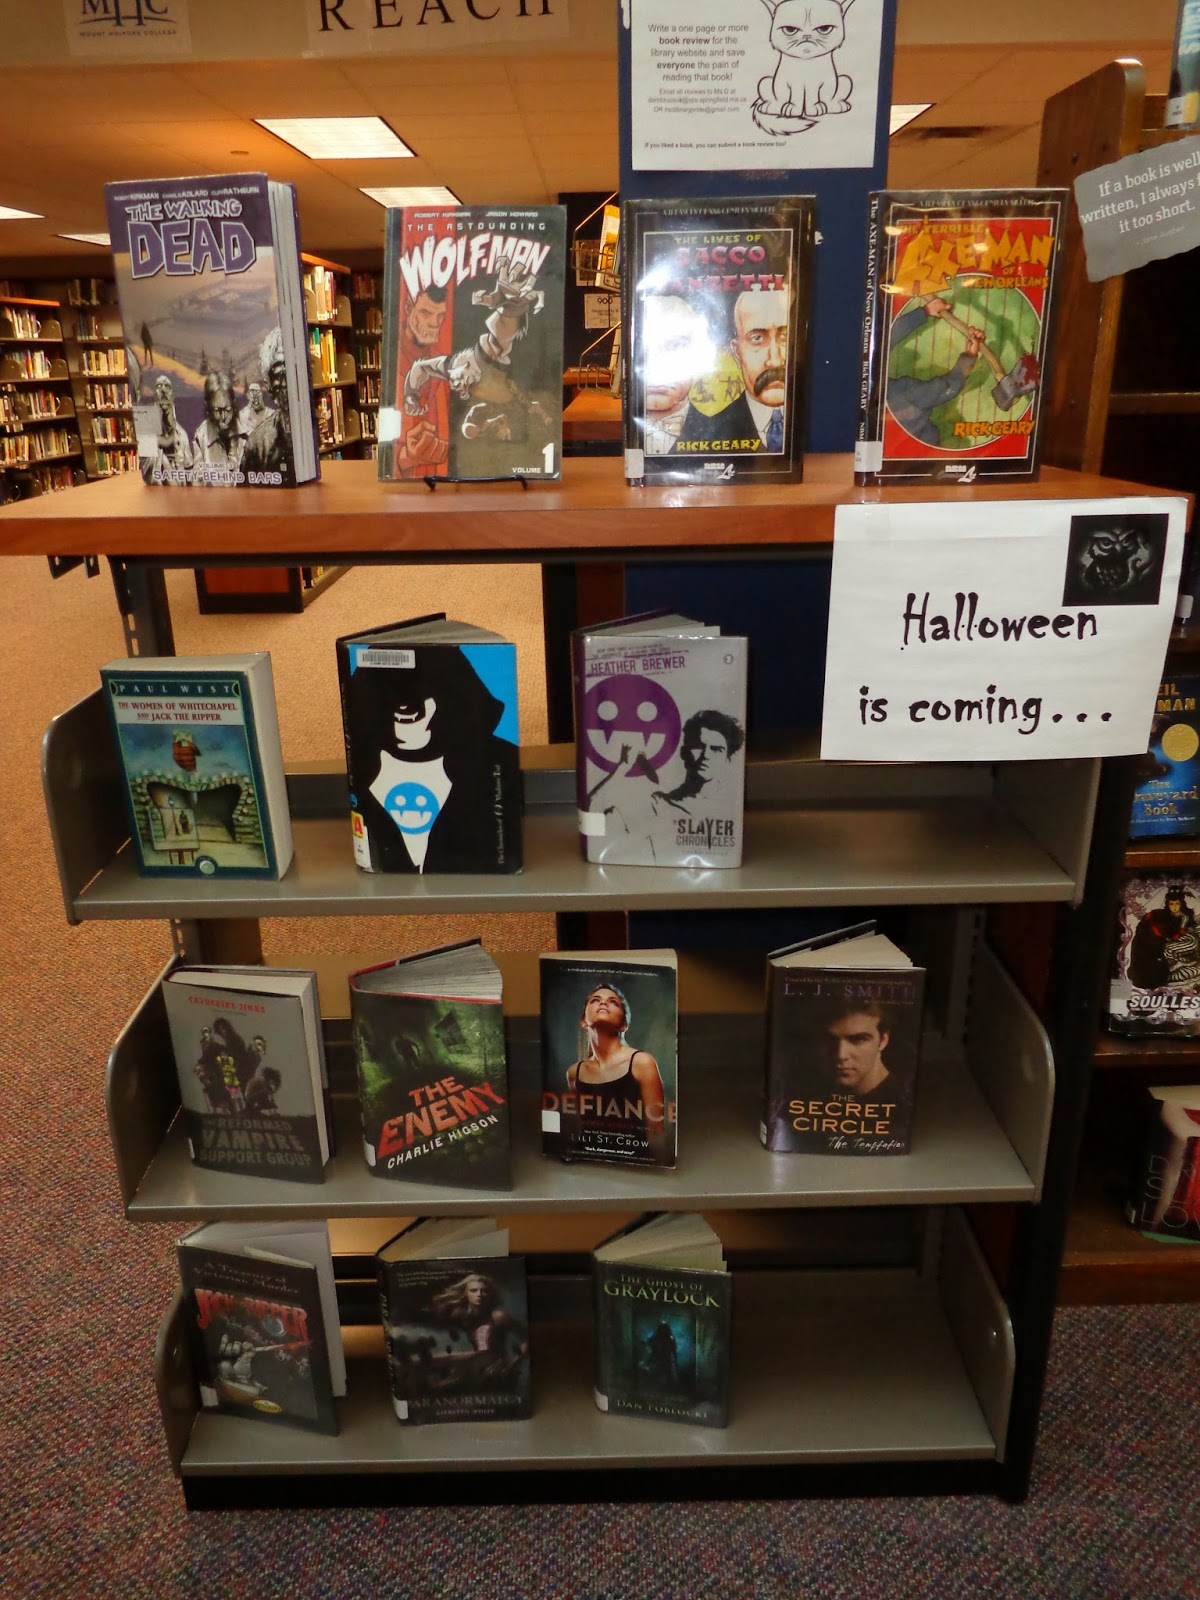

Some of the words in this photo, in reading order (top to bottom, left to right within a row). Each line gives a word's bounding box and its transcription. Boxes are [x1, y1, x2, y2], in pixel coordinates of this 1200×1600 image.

[648, 24, 669, 32] Write
[696, 26, 715, 34] page
[651, 49, 675, 58] library
[657, 61, 695, 69] everyone
[712, 61, 729, 70] pain
[662, 73, 692, 82] reading
[1098, 182, 1109, 198] If
[1114, 182, 1122, 192] a
[1125, 168, 1157, 189] book
[1159, 164, 1170, 178] is
[1172, 150, 1200, 172] well
[125, 202, 164, 221] THE
[164, 198, 242, 220] WALKING
[869, 198, 878, 218] The
[1081, 196, 1138, 224] written,
[1141, 192, 1146, 204] I
[1148, 178, 1194, 202] always
[1119, 219, 1129, 233] it
[1132, 214, 1153, 229] too
[1155, 199, 1195, 222] short.
[447, 222, 546, 230] ASTOUNDING
[924, 223, 986, 234] TERRIBLE
[704, 235, 740, 243] LIVES
[128, 218, 256, 279] DEAD
[677, 246, 766, 266] SACCO
[867, 222, 877, 276] AXE-MAN
[1002, 266, 1015, 275] OF
[658, 273, 784, 292] ANZETTI
[866, 279, 874, 290] of
[995, 275, 1049, 289] ORLEANS
[864, 292, 873, 314] New
[863, 316, 872, 353] Orleans
[954, 421, 990, 437] RICK
[991, 420, 1035, 436] GEARY
[676, 441, 709, 451] RICK
[711, 439, 762, 450] GEARY
[542, 442, 554, 473] 1
[154, 470, 199, 482] SAFETY
[203, 472, 245, 483] BEHIND
[249, 471, 282, 484] BARS
[903, 592, 1098, 646] Halloween
[591, 660, 636, 674] HEATHER
[643, 656, 685, 670] BREWER
[181, 685, 229, 694] WEST
[1158, 684, 1180, 695] EIL
[179, 703, 237, 711] WHITECHAPEL
[859, 685, 888, 725] is
[1157, 698, 1196, 711] MAN
[152, 713, 172, 721] JACK
[1134, 786, 1198, 805] raveyard
[1144, 803, 1179, 816] Book
[354, 816, 363, 835] A
[678, 818, 734, 843] SLAYER
[784, 983, 803, 995] L.
[814, 984, 831, 996] J.
[844, 985, 915, 998] SMITH
[188, 996, 235, 1009] CATHERINE
[240, 1003, 265, 1014] JINKS
[408, 1076, 464, 1106] THE
[832, 1094, 855, 1102] THE
[542, 1092, 676, 1124] DEFIANCE
[789, 1100, 896, 1118] SECRET
[219, 1118, 292, 1131] REFORMED
[378, 1082, 505, 1159] ENEMY
[793, 1118, 890, 1134] CIRCLE
[202, 1130, 304, 1151] VAMPIRE
[387, 1137, 443, 1170] CHARLIE
[450, 1114, 499, 1142] HIGSON
[616, 1137, 649, 1148] CROW
[829, 1136, 848, 1148] The
[854, 1138, 905, 1153] Temptation
[200, 1150, 262, 1164] SUPPORT
[266, 1152, 312, 1166] GROUP
[621, 1274, 640, 1284] THE
[647, 1278, 684, 1289] GHOST
[604, 1280, 720, 1307] GRAYLOCK
[409, 1393, 522, 1408] ARANORMALCY
[616, 1400, 642, 1409] DAN
[648, 1401, 707, 1418] POBLOCKI
